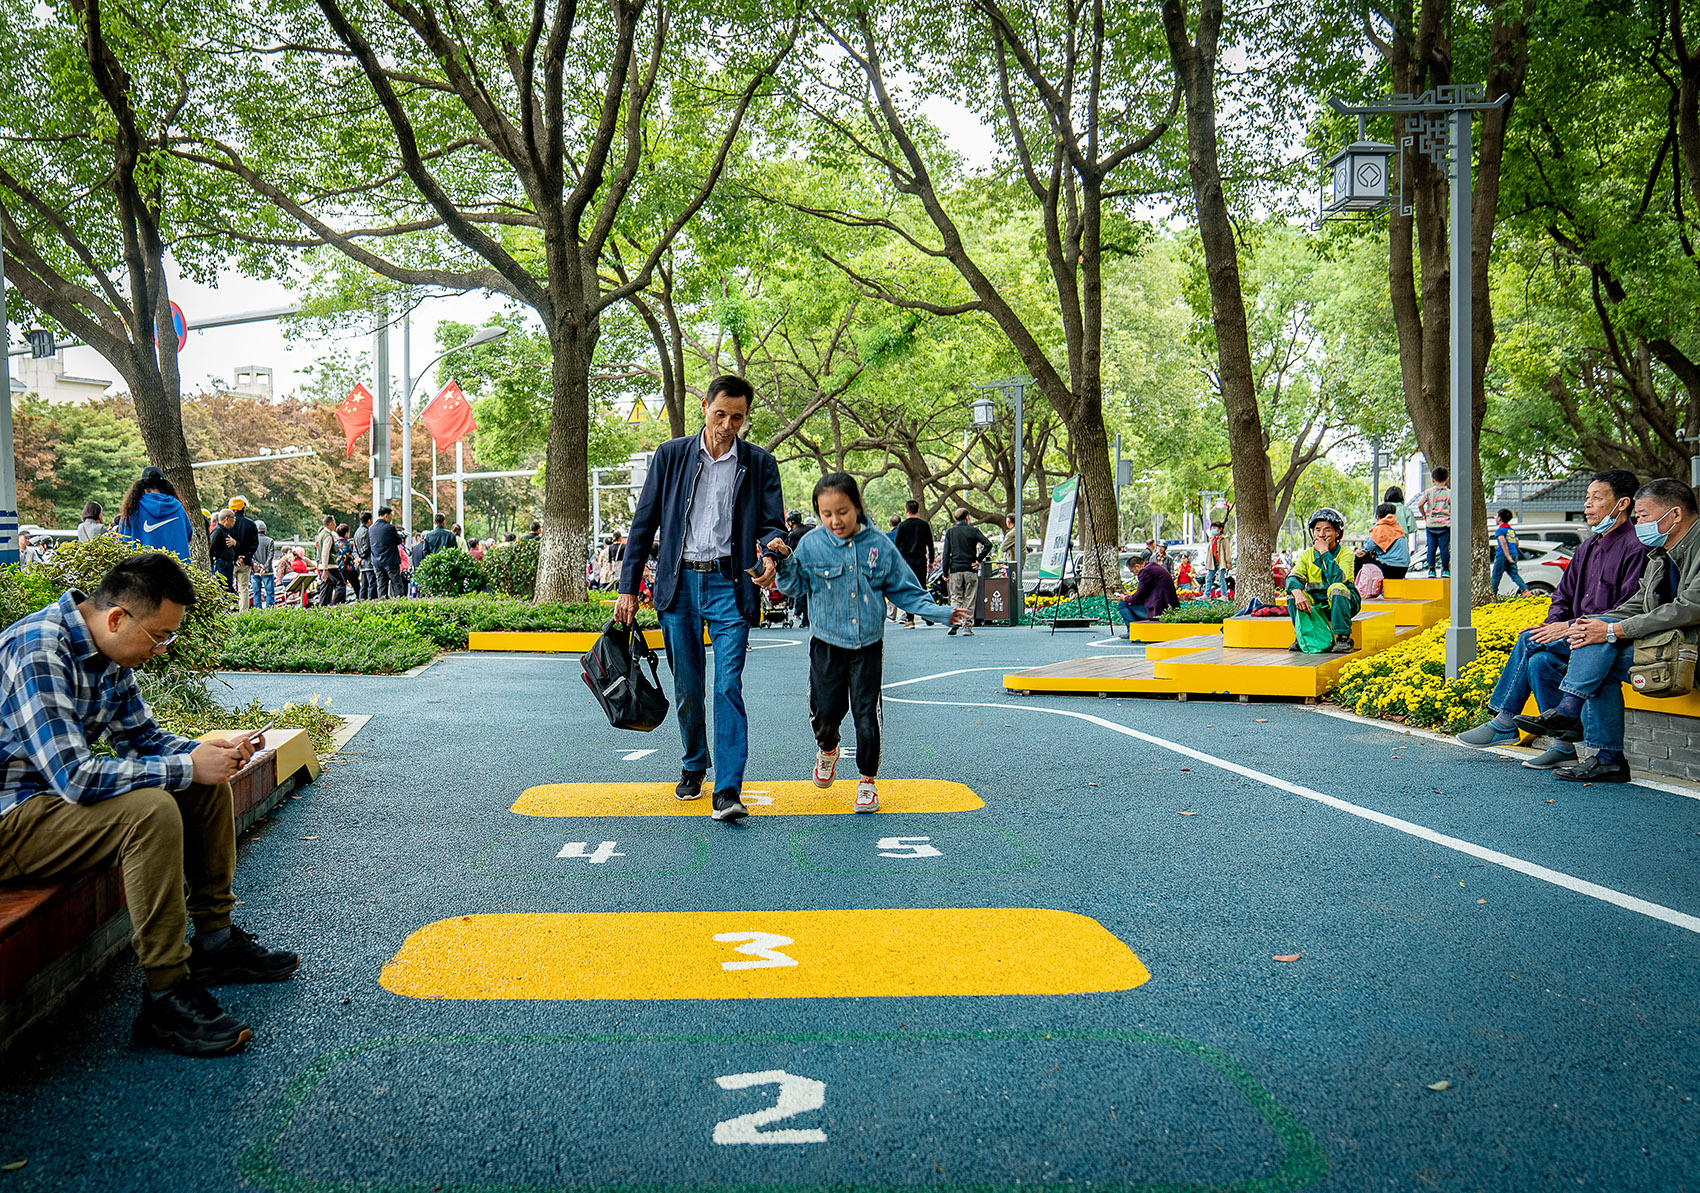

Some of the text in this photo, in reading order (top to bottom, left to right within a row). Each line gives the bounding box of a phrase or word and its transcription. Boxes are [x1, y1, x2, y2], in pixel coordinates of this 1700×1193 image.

[615, 749, 659, 761] 7
[556, 841, 626, 863] 4
[877, 836, 943, 858] 5
[713, 932, 798, 971] 3
[713, 1070, 827, 1145] 2
